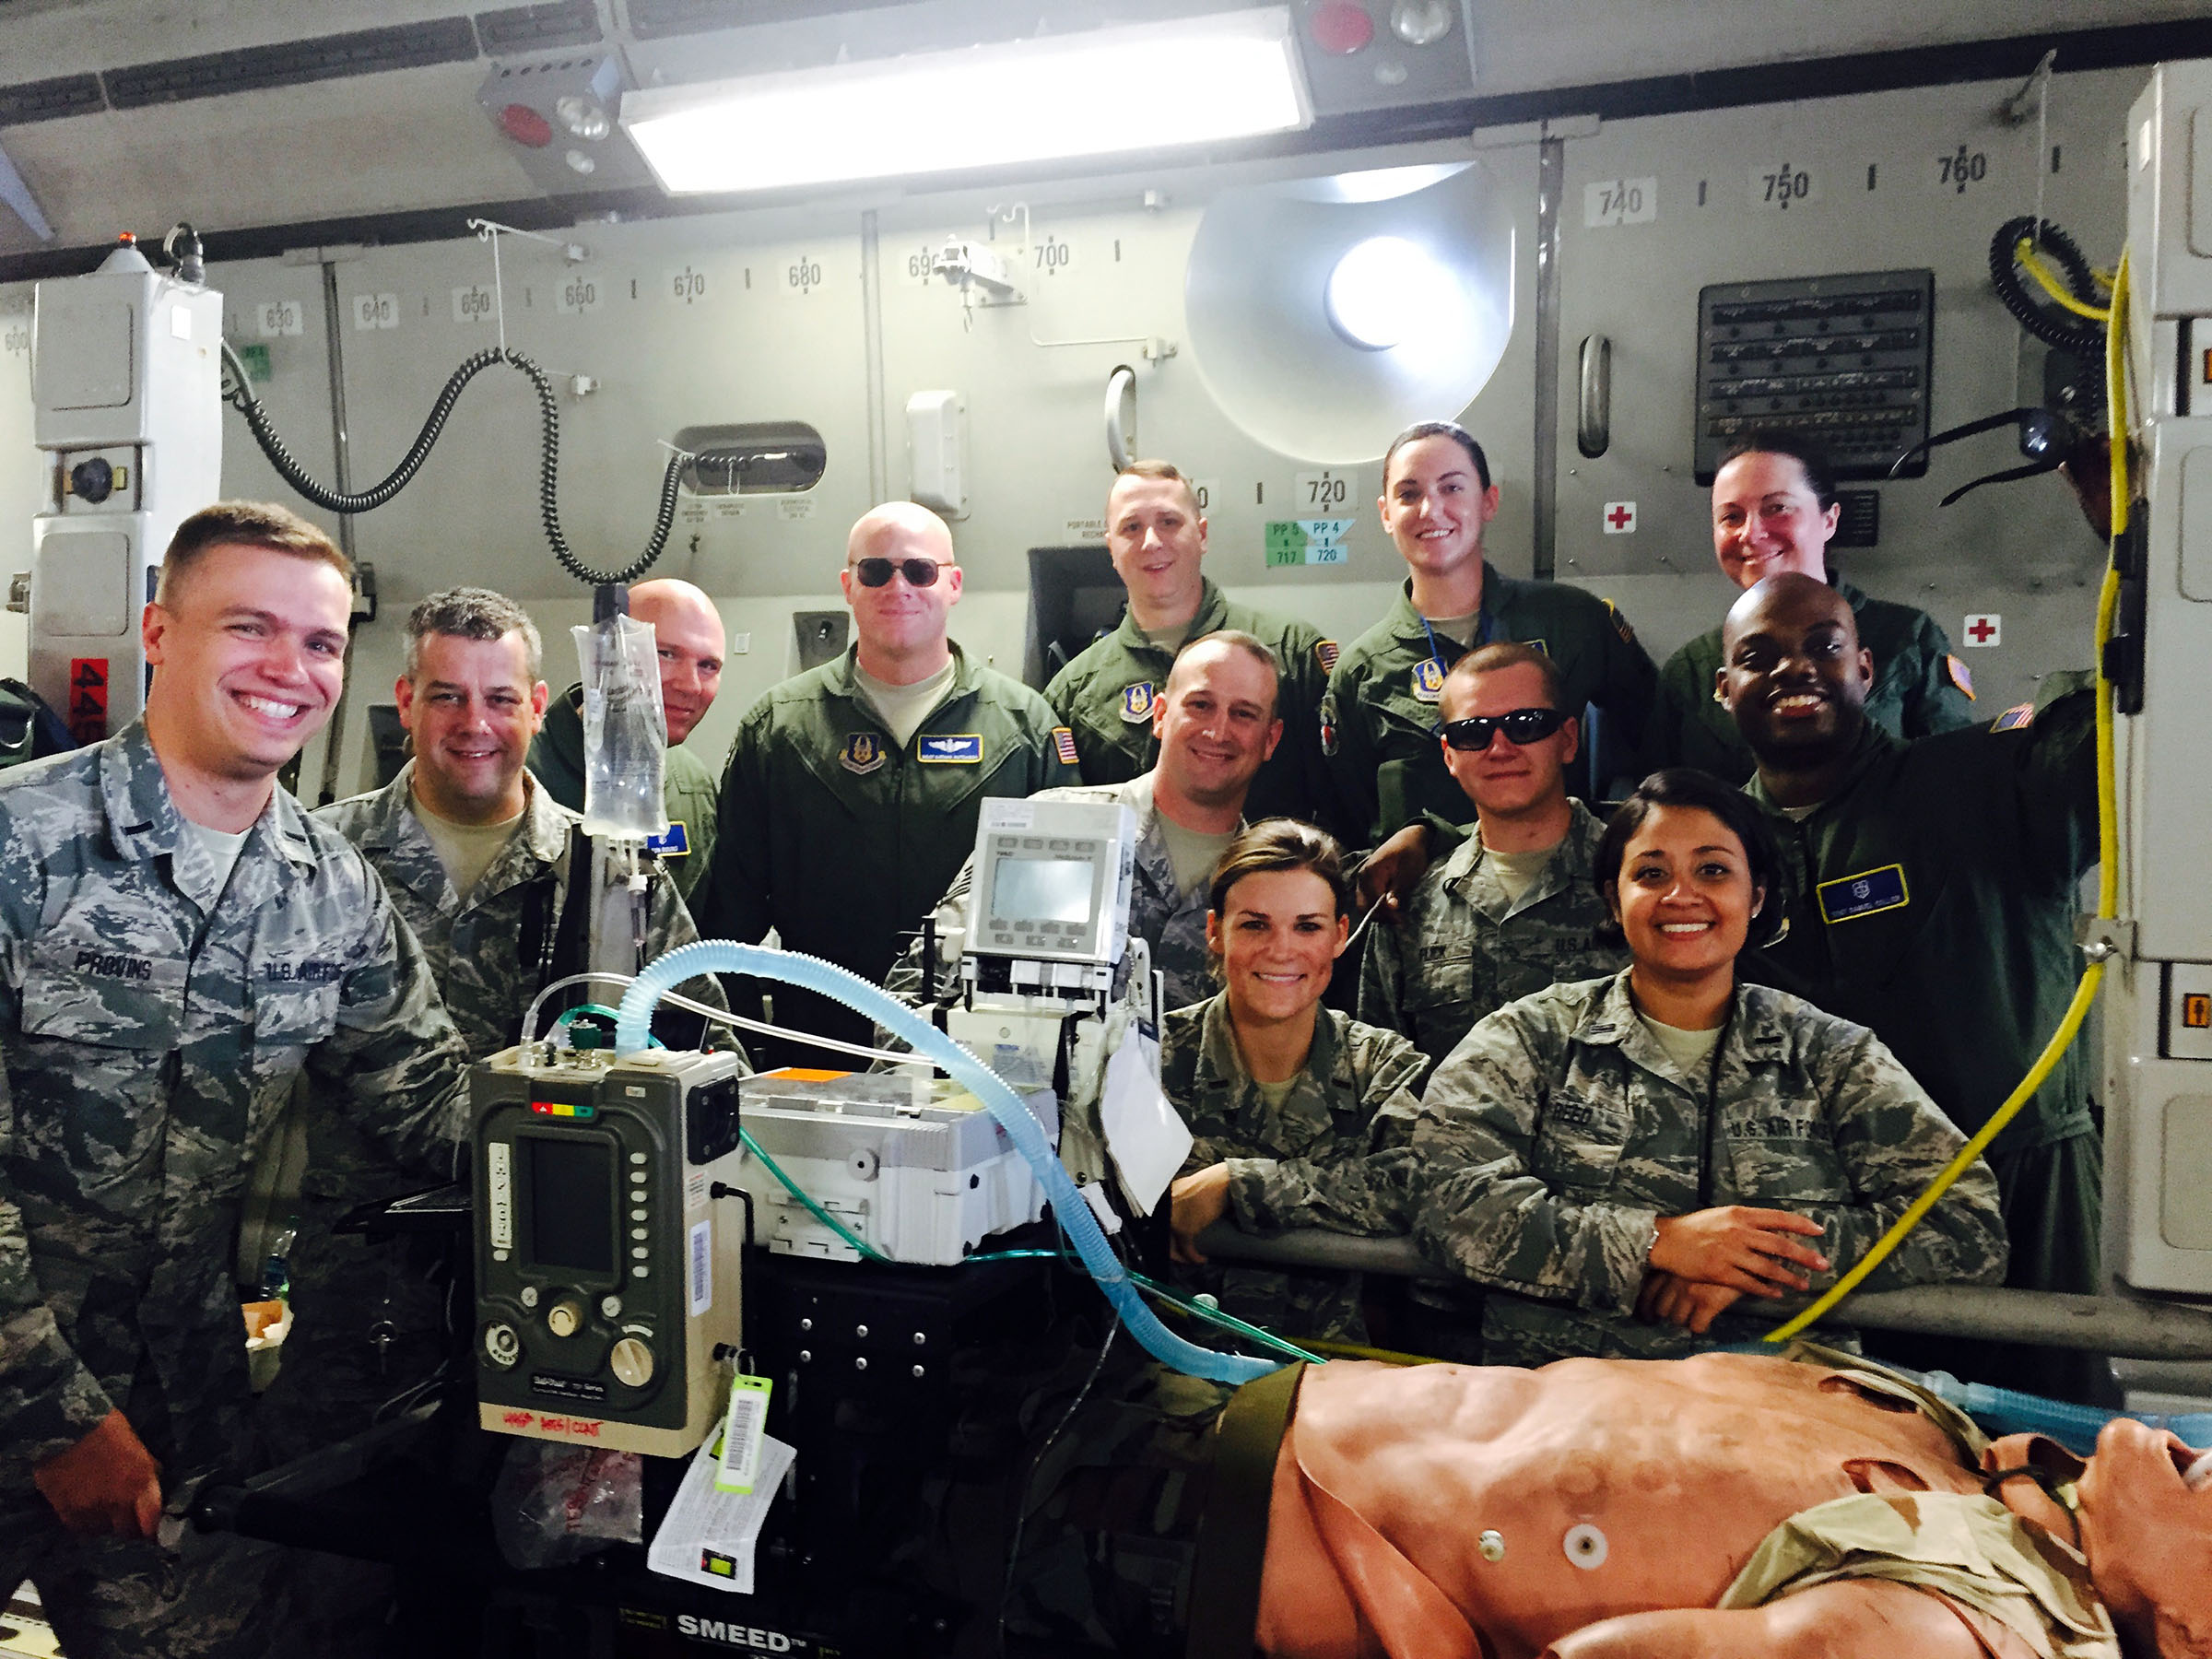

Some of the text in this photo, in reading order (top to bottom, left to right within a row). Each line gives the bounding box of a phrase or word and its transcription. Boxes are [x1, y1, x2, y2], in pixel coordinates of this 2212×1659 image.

[1937, 153, 1987, 184] 760
[1762, 171, 1809, 201] 750
[1599, 187, 1642, 216] 740
[1034, 243, 1069, 268] 700
[674, 274, 705, 296] 670
[789, 264, 821, 288] 680
[462, 291, 490, 314] 650
[565, 283, 595, 306] 660
[362, 300, 390, 322] 640
[1307, 479, 1346, 504] 720
[1273, 523, 1286, 536] PP
[1313, 521, 1339, 534] PP 4
[1277, 551, 1298, 563] 717
[1317, 548, 1337, 562] 720
[74, 950, 153, 981] PROVINS
[1553, 1102, 1594, 1124] REED
